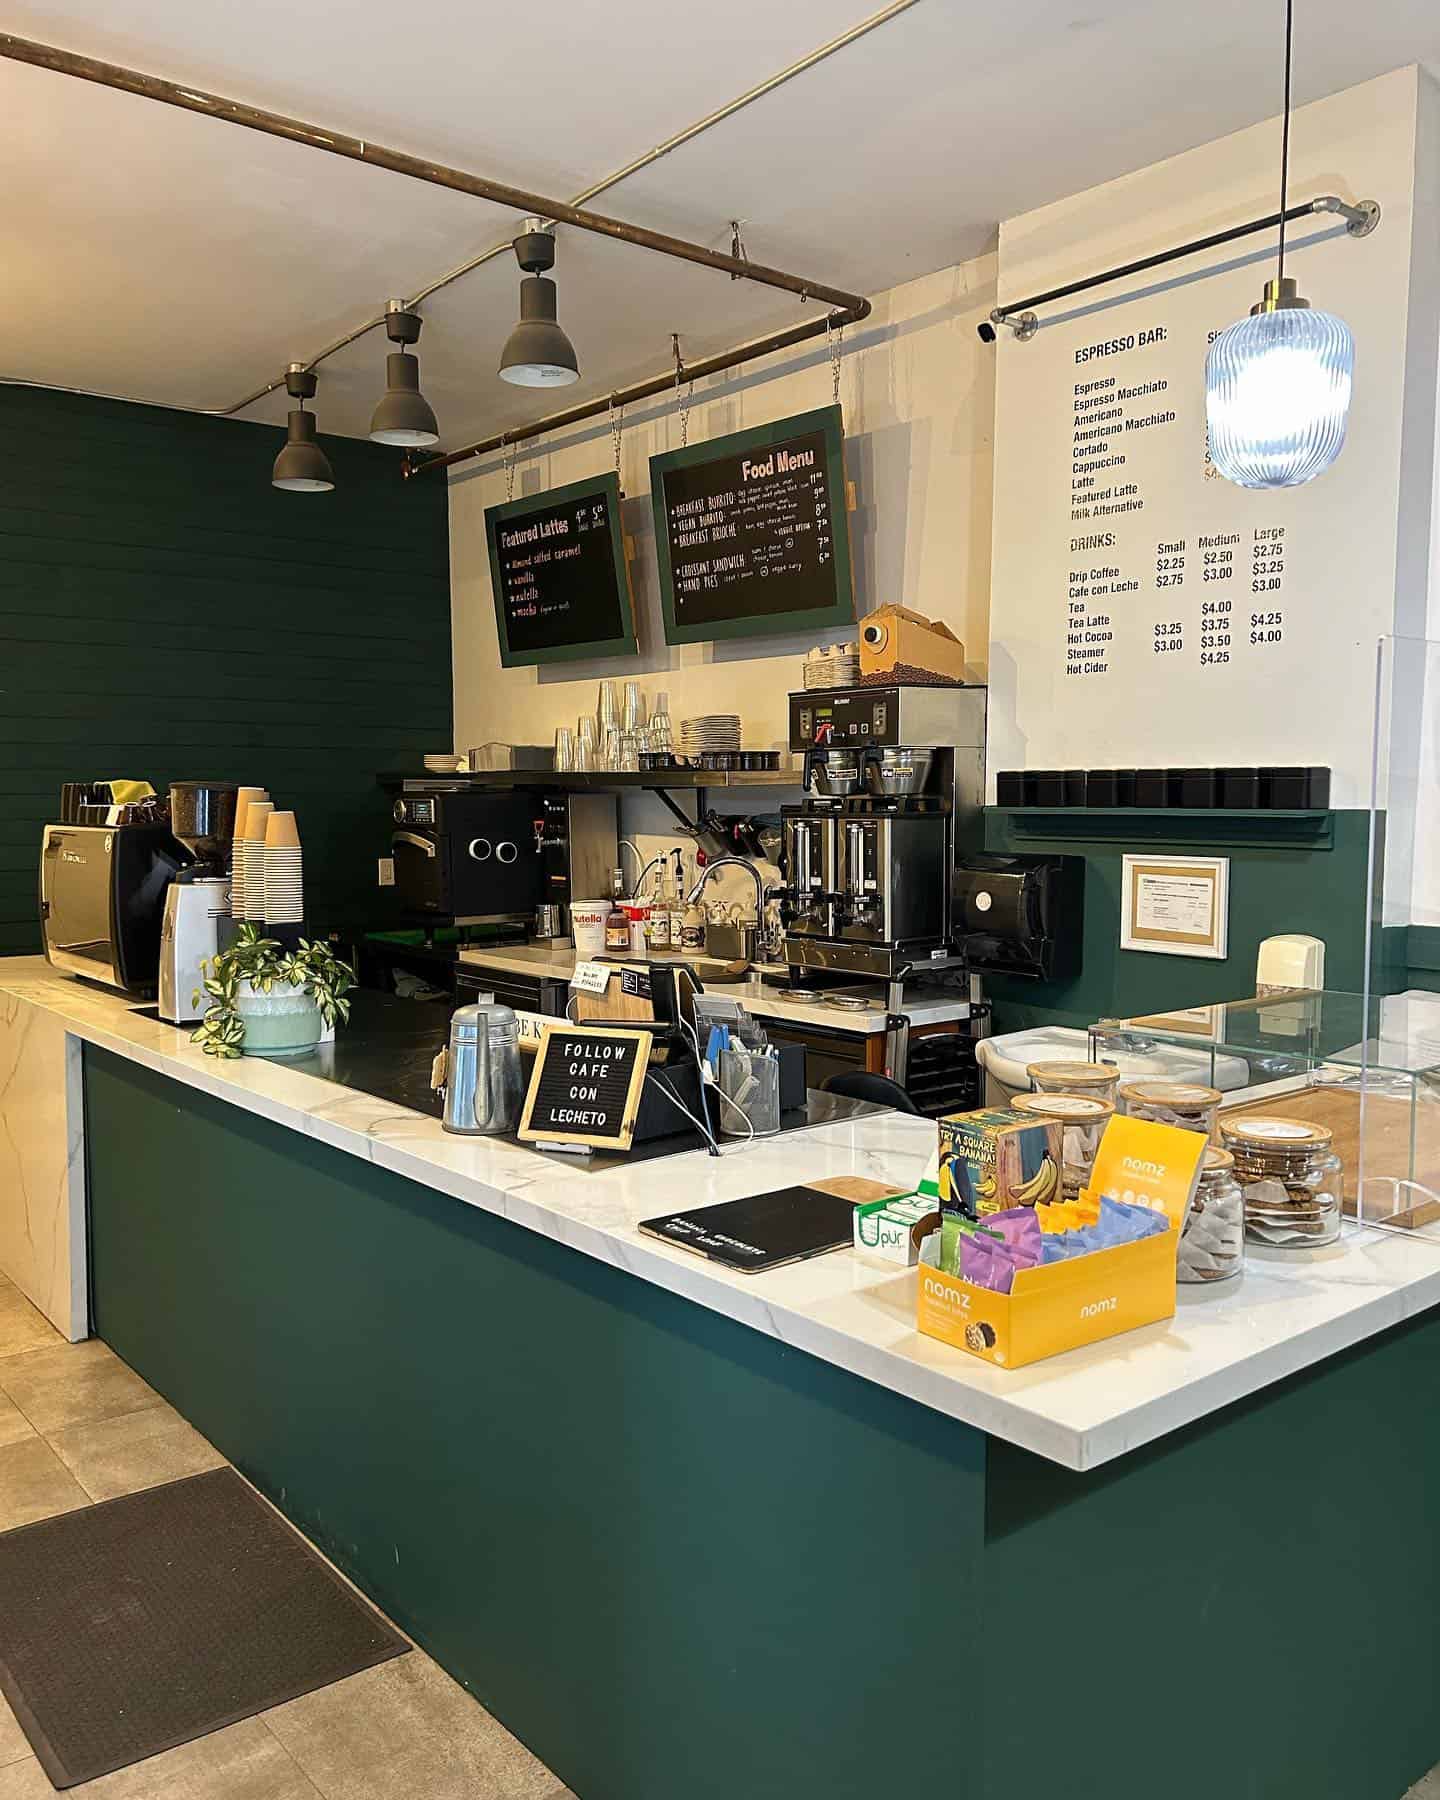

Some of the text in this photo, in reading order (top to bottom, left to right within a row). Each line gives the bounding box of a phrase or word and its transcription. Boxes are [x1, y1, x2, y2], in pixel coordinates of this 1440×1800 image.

[1075, 327, 1168, 363] ESPRESSO BAR:
[1073, 379, 1168, 411] Espresso Macchiato
[1074, 377, 1116, 396] Espresso
[1073, 407, 1123, 427] Americano
[1073, 411, 1176, 443] Americano Macchiato
[1073, 442, 1108, 458] Cortado
[742, 450, 815, 481] Food Menu
[1072, 454, 1126, 474] Cappuccino
[1071, 483, 1138, 505] Featured Latte
[1072, 476, 1095, 490] Latte
[1071, 499, 1144, 521] Milk Alternative
[501, 524, 539, 549] Featured
[540, 519, 569, 538] Lattes
[1070, 532, 1116, 552] DRINKS:
[1157, 540, 1186, 555] Small
[1254, 526, 1285, 541] Large
[1069, 543, 1283, 585] Drip Coffee $2.25 $2.50 $2.75
[1069, 560, 1284, 599] Cafe con Leche $2.75 $3.00 $3.25
[1068, 577, 1281, 614] Tea $3.00
[1068, 600, 1232, 629] Tea Latte $4.00
[1067, 612, 1282, 645] Hot Cocoa $3.25 $3.75 $4.25
[1067, 629, 1282, 660] Steamer $3.00 $3.50 $4.00
[1066, 651, 1230, 675] Hot Cider $4.25
[564, 1043, 626, 1060] FOLLOW
[569, 1062, 610, 1078] CAFE
[569, 1086, 598, 1101] CON
[550, 1108, 606, 1126] LECHETO
[941, 1129, 996, 1153] TRY A SQUARE
[960, 1145, 996, 1164] BANANA!
[1122, 1156, 1167, 1177] nomz
[924, 1277, 972, 1309] nomz
[1080, 1296, 1118, 1320] nomz
